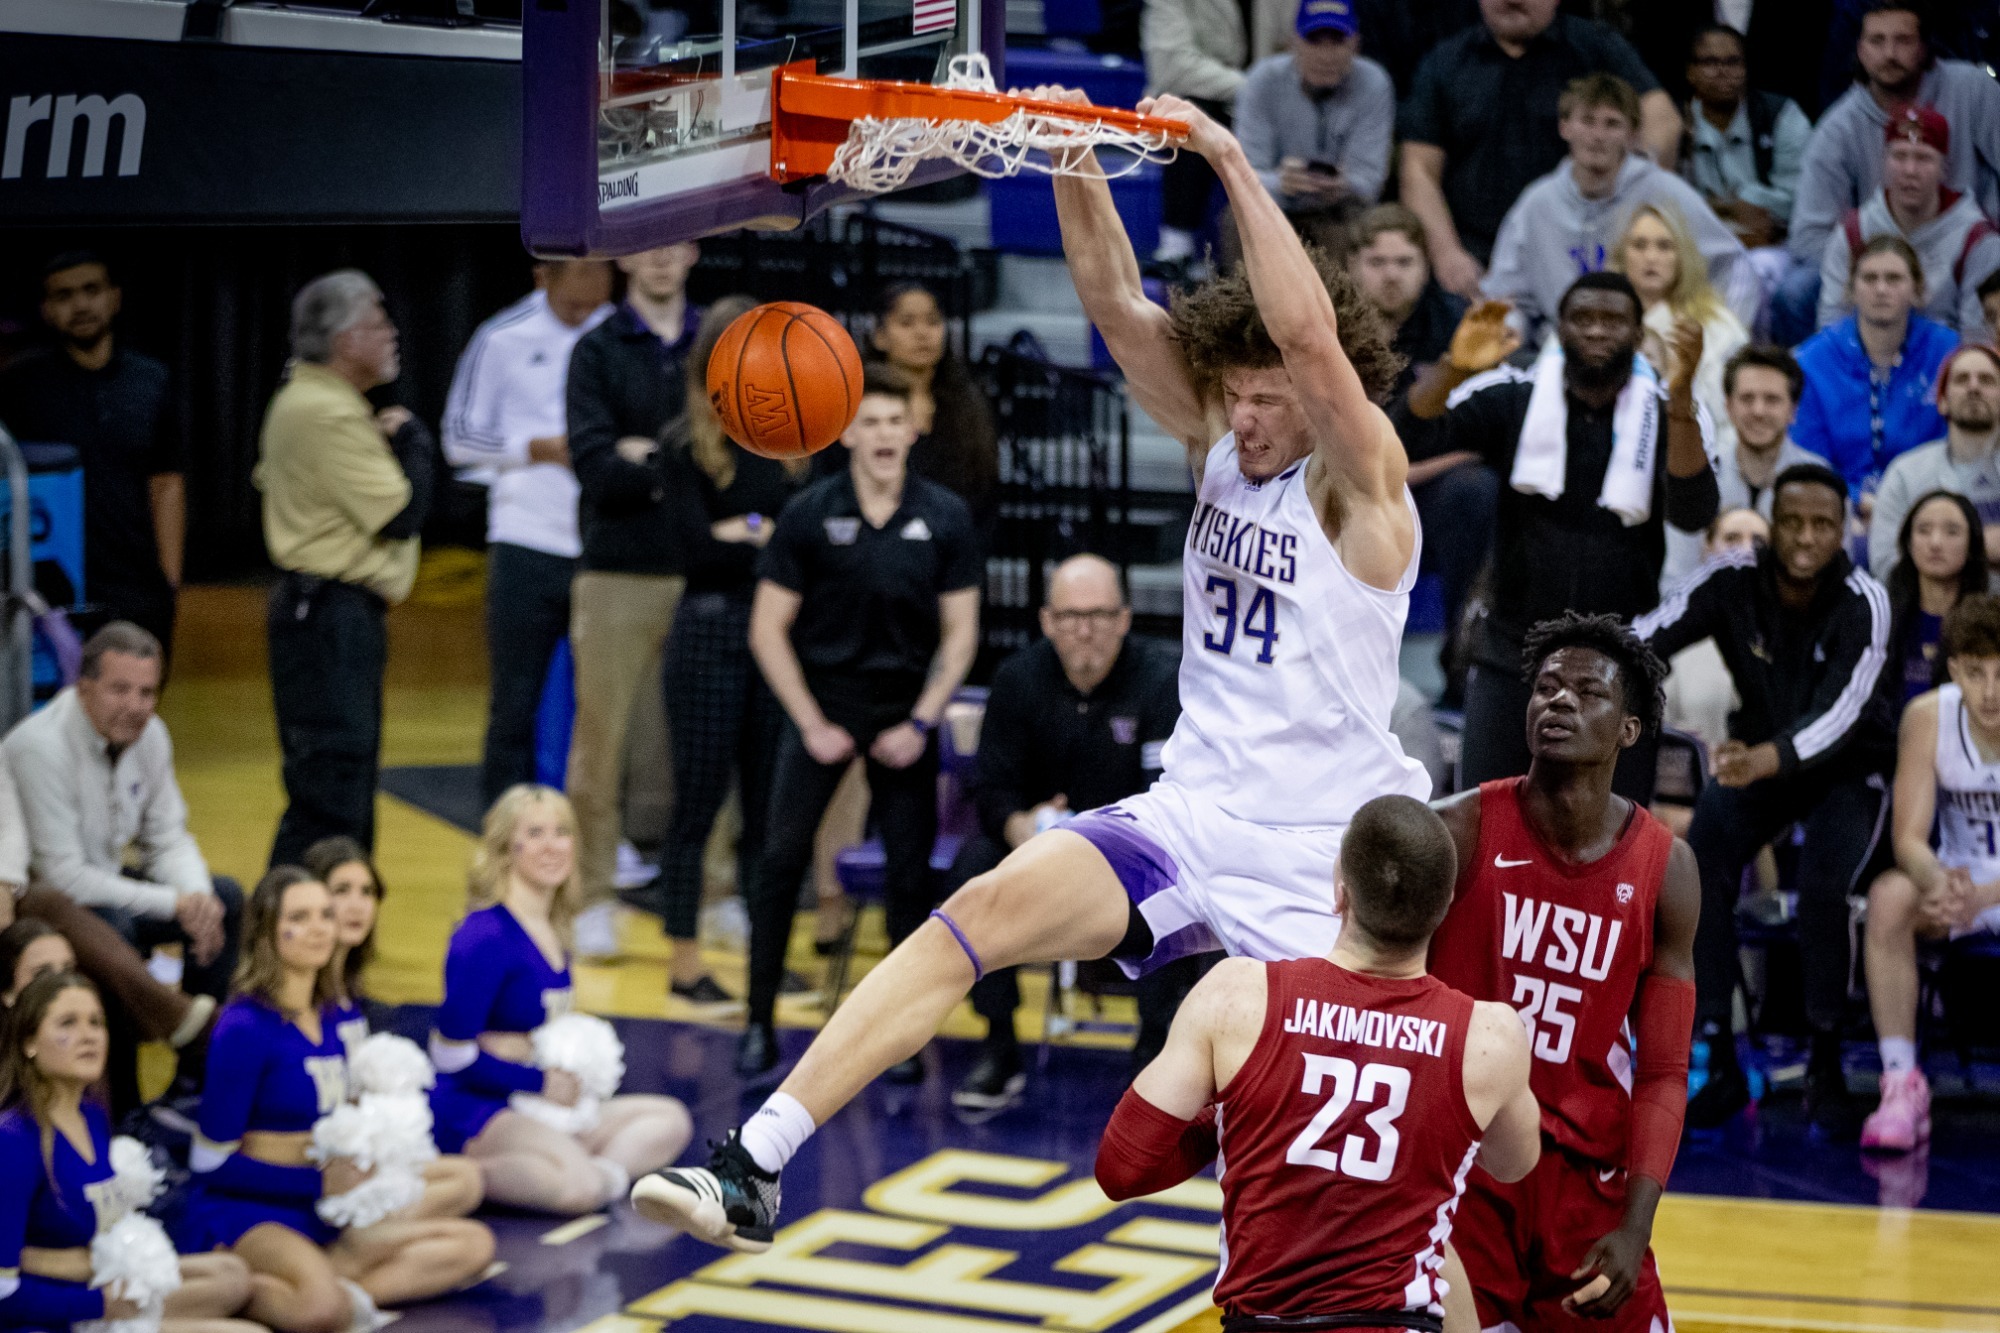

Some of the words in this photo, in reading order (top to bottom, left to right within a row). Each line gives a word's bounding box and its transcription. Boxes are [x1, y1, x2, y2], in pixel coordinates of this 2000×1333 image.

[1, 92, 147, 179] rm
[1190, 501, 1298, 586] HUSKIES
[1203, 572, 1281, 668] 34
[1502, 890, 1623, 982] WSU
[1284, 997, 1447, 1058] JAKIMOVSKI
[1511, 973, 1583, 1064] 35
[1285, 1051, 1412, 1182] 23
